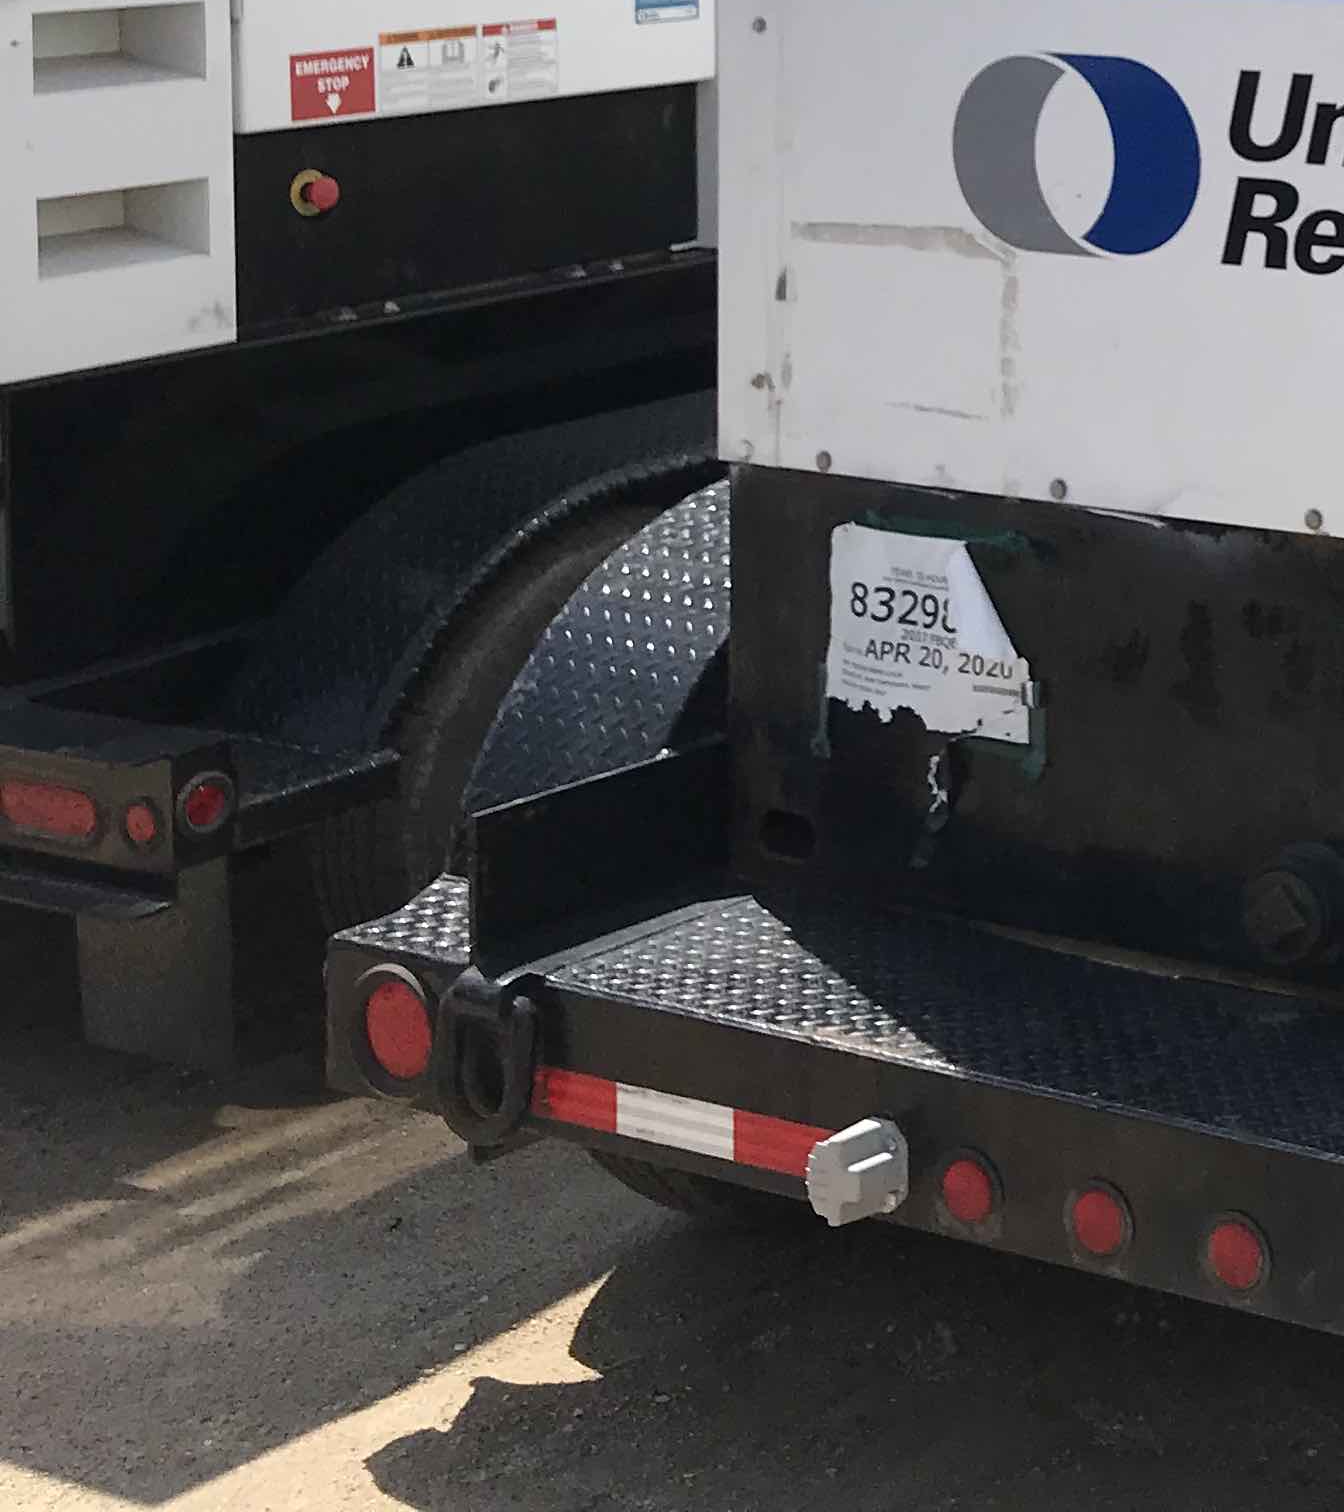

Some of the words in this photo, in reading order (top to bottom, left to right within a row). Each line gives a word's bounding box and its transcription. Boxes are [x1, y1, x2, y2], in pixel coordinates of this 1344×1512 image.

[295, 55, 370, 77] EMERGENCY
[317, 75, 350, 94] STOP
[865, 639, 911, 664] APR
[919, 646, 948, 675] 20,
[958, 652, 1013, 679] 2020
